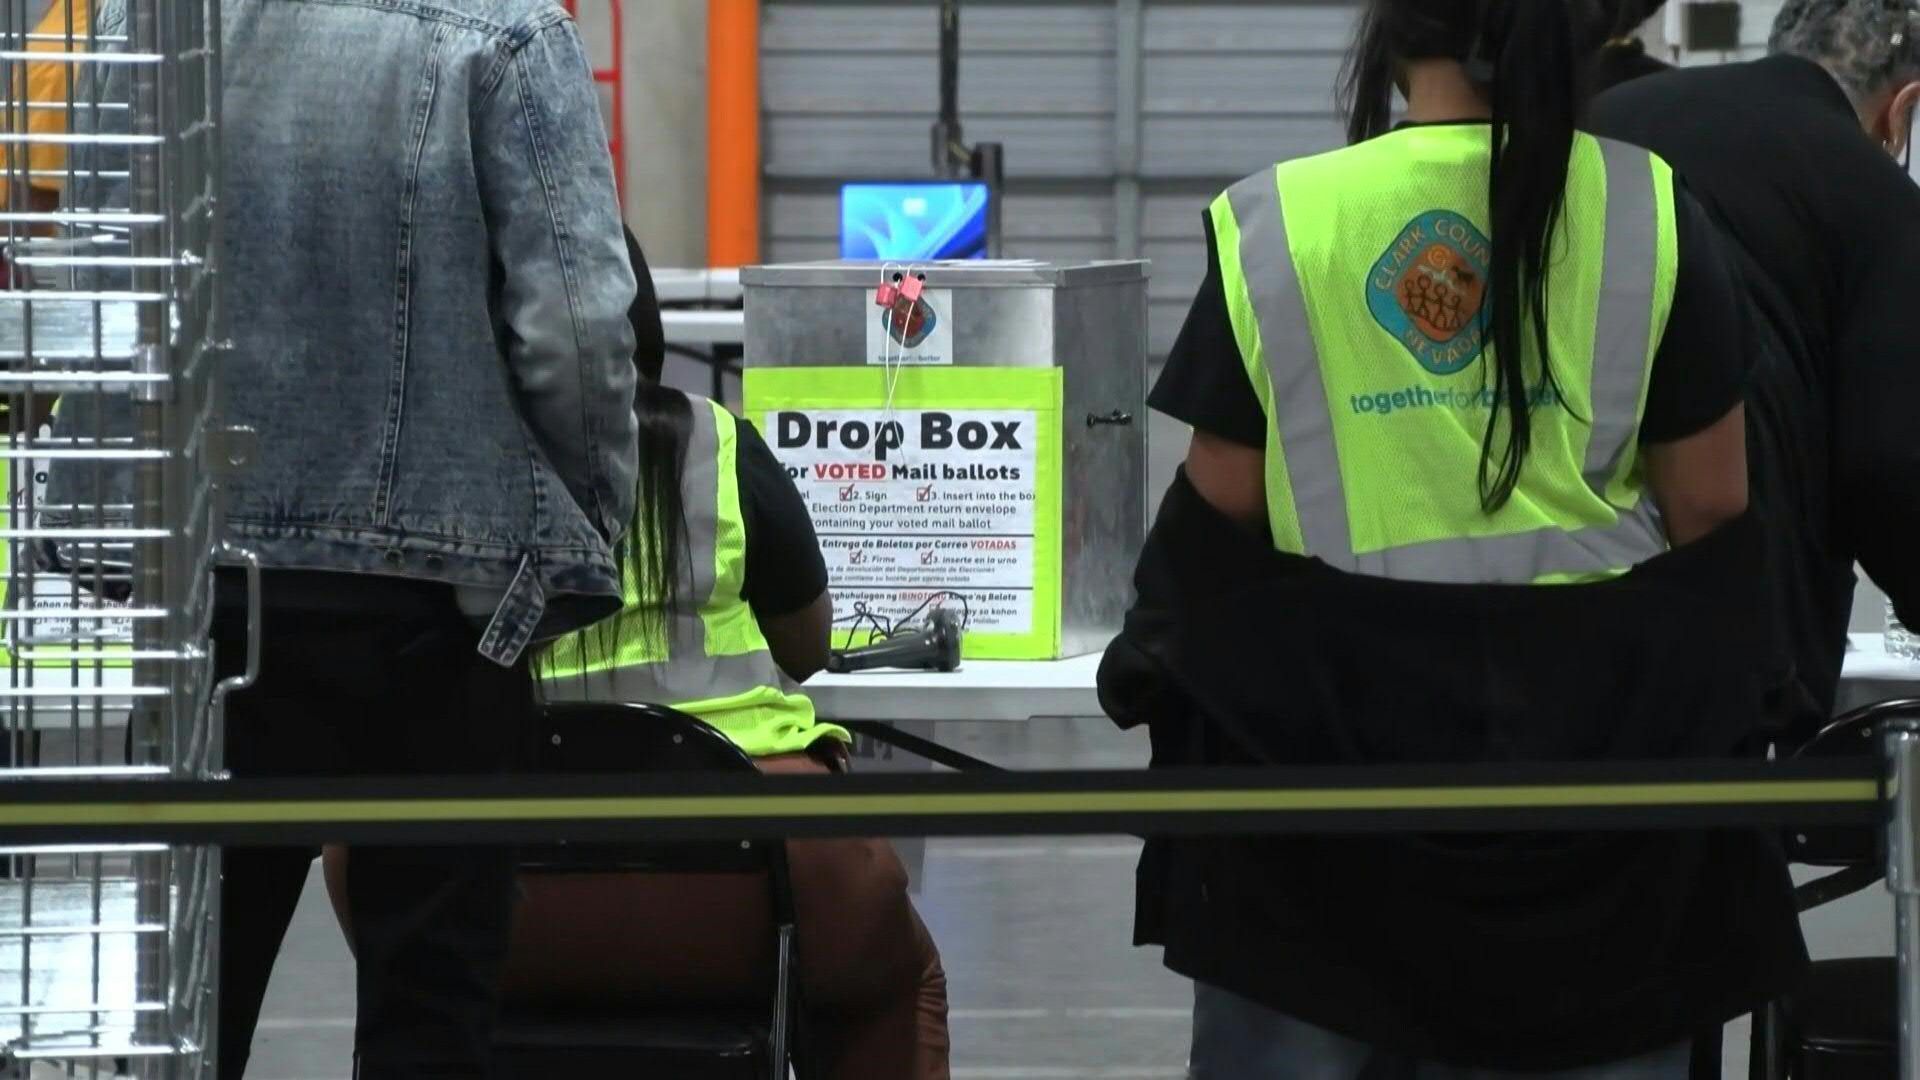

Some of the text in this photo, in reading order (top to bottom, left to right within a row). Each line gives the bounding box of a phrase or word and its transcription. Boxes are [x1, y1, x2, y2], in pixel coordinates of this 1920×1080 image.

[1375, 218, 1490, 290] CLARK COUN
[777, 411, 1023, 461] Drop Box
[814, 463, 887, 480] VOTED
[891, 463, 938, 480] Mail
[942, 463, 1021, 481] ballots
[865, 490, 888, 502] Sign
[943, 491, 973, 501] Insert
[976, 491, 997, 501] into
[999, 491, 1017, 501] the
[812, 503, 1017, 516] Election Department return envelope
[813, 518, 992, 530] ontaining your voted mail ballot
[822, 539, 1017, 551] Entrega de Boletas por Correo VOTADAS
[872, 555, 896, 563] Firme
